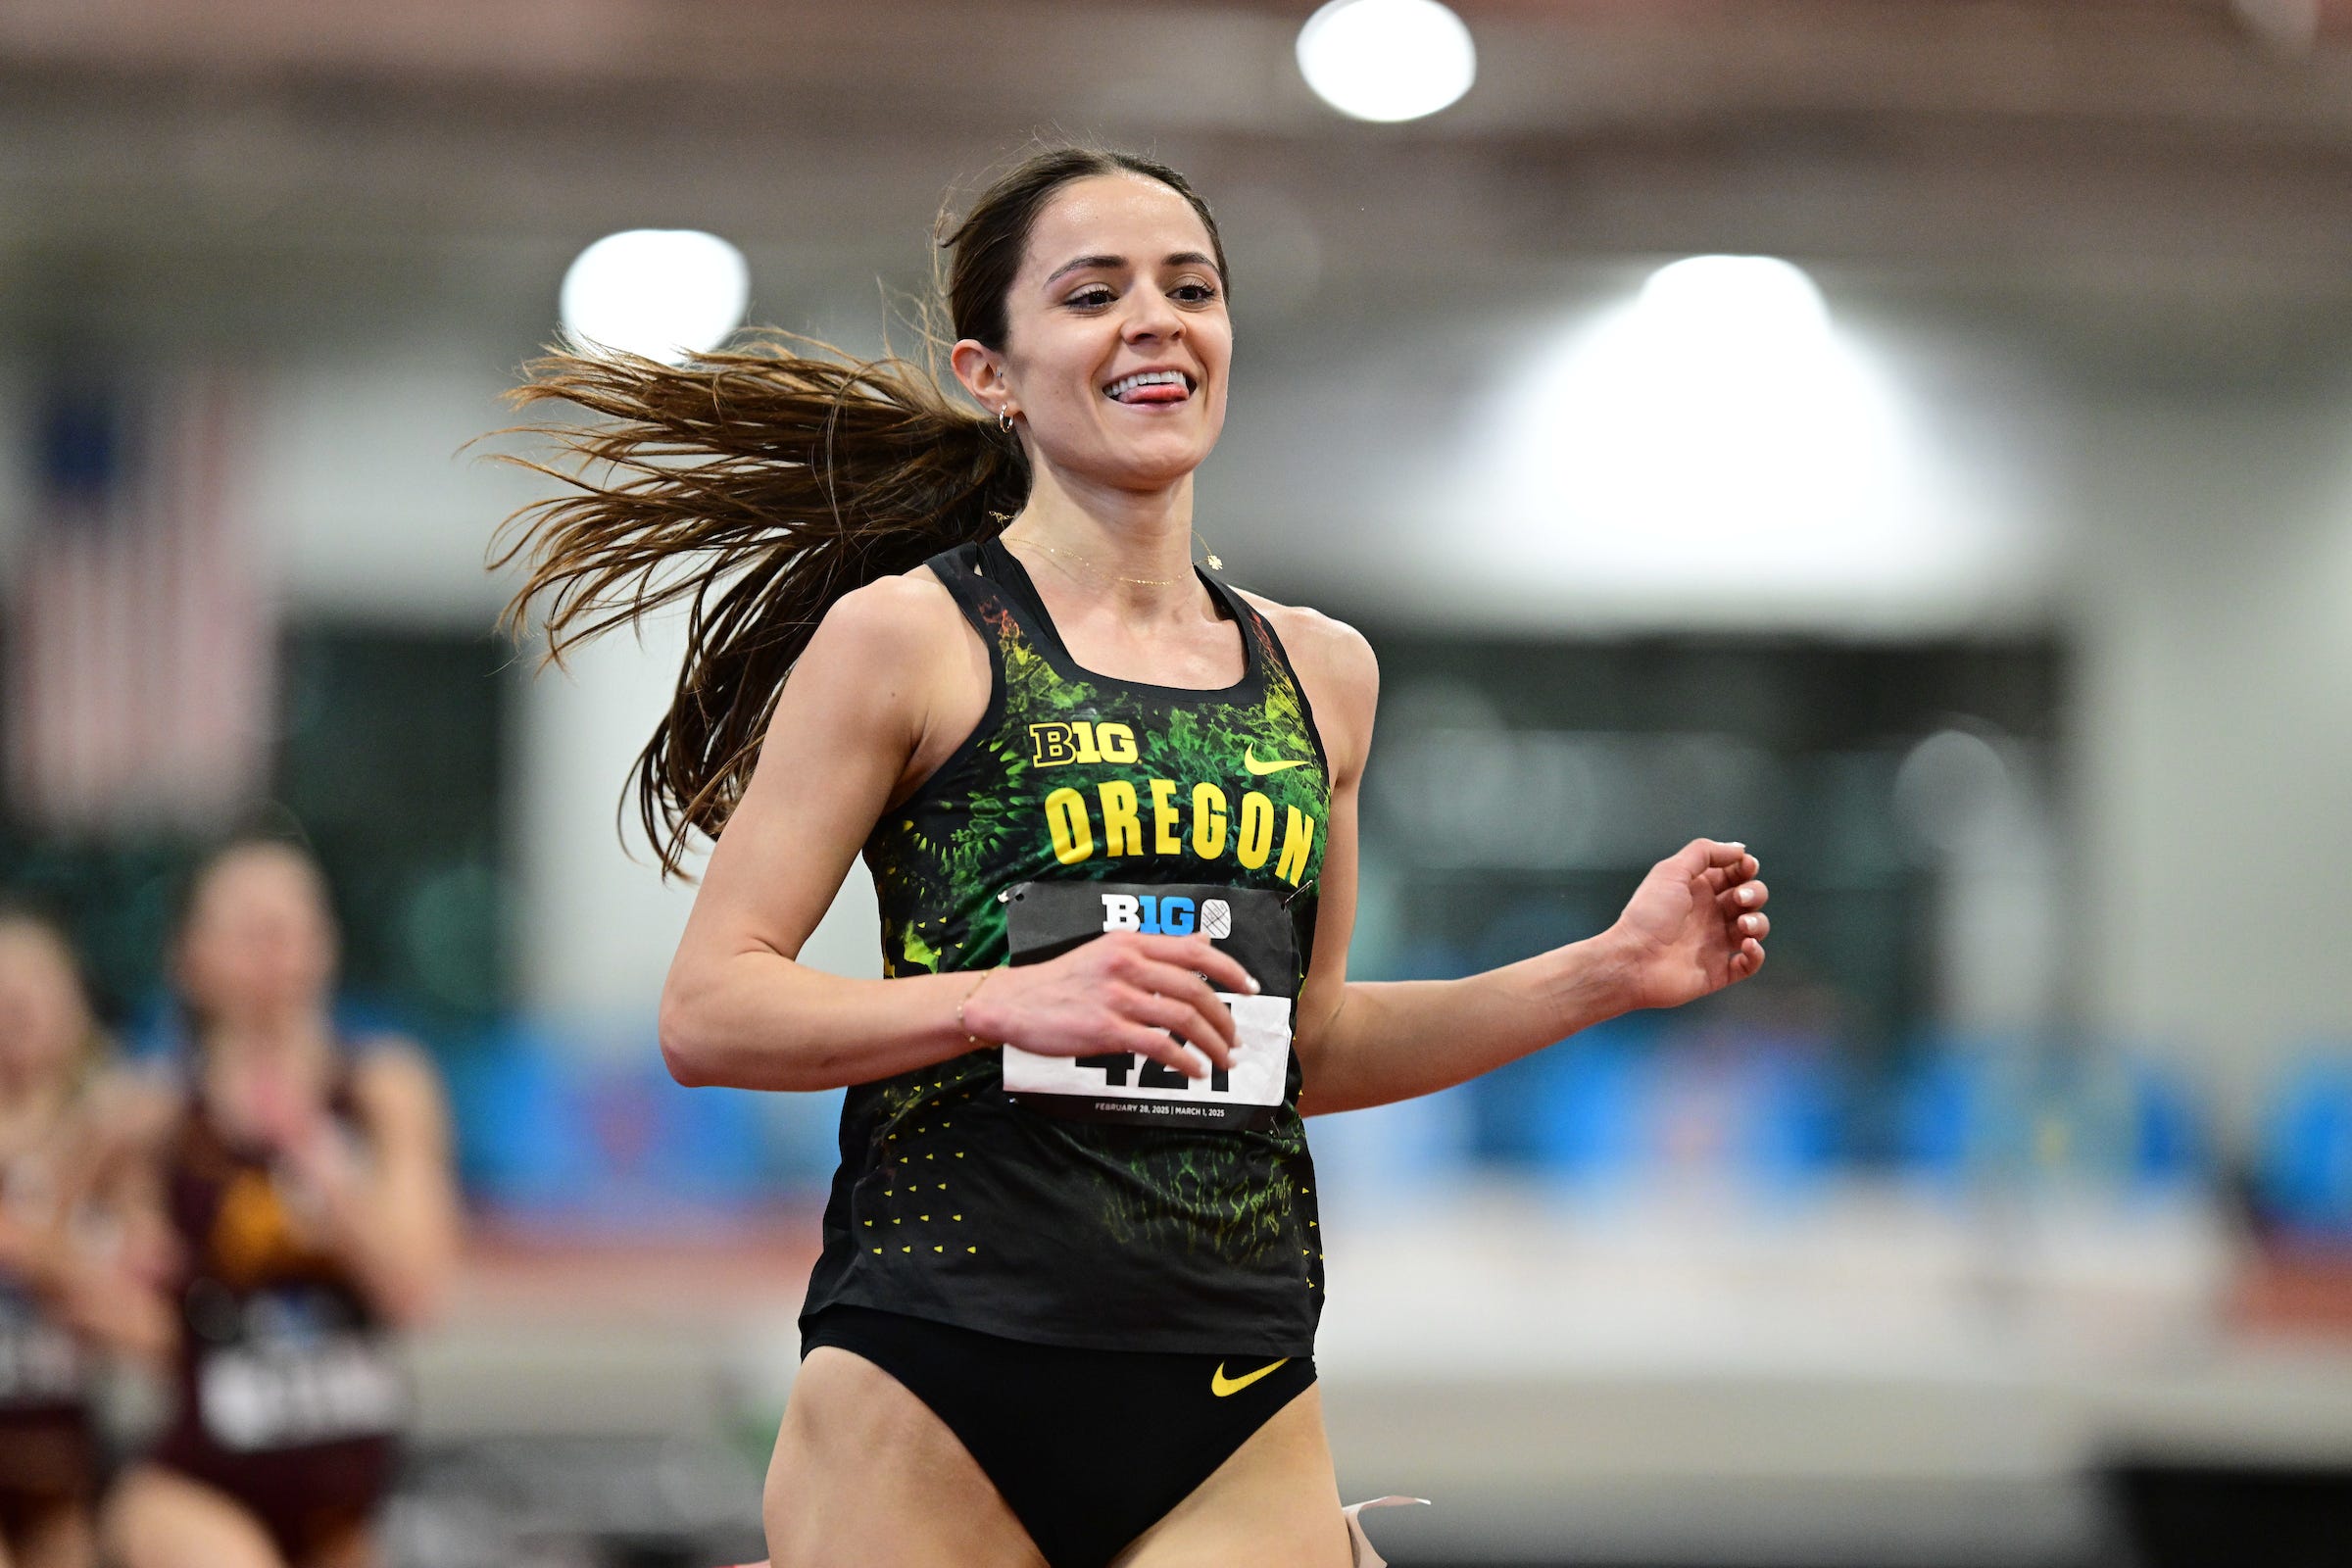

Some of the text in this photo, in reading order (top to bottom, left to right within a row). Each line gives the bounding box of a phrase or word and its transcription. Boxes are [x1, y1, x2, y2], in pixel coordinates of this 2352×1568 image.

[1044, 779, 1315, 888] OREGON
[1095, 1102, 1138, 1112] FEBRUARY
[1152, 1105, 1170, 1115] 2025
[1175, 1106, 1200, 1115] MARCH
[1208, 1108, 1224, 1117] 2025
